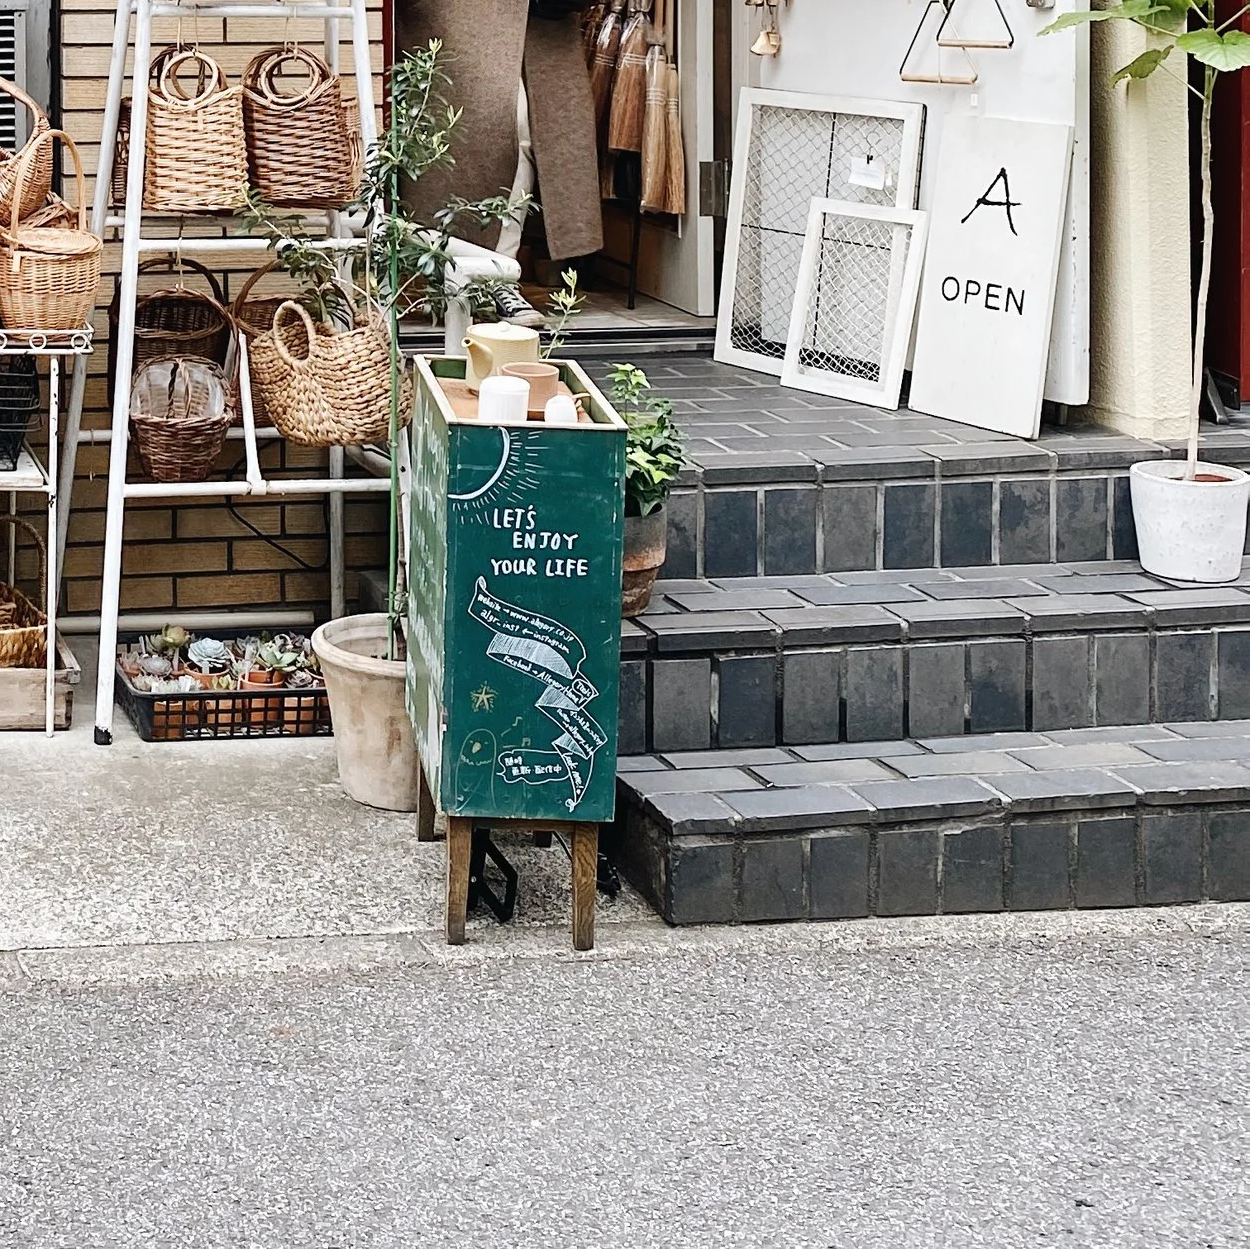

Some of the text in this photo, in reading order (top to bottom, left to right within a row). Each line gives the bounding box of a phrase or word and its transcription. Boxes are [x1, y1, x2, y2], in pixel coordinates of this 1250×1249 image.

[942, 276, 1025, 315] OPEN
[493, 505, 536, 530] LET'S
[513, 532, 579, 550] ENJOY
[491, 559, 588, 577] YOUR LIFE
